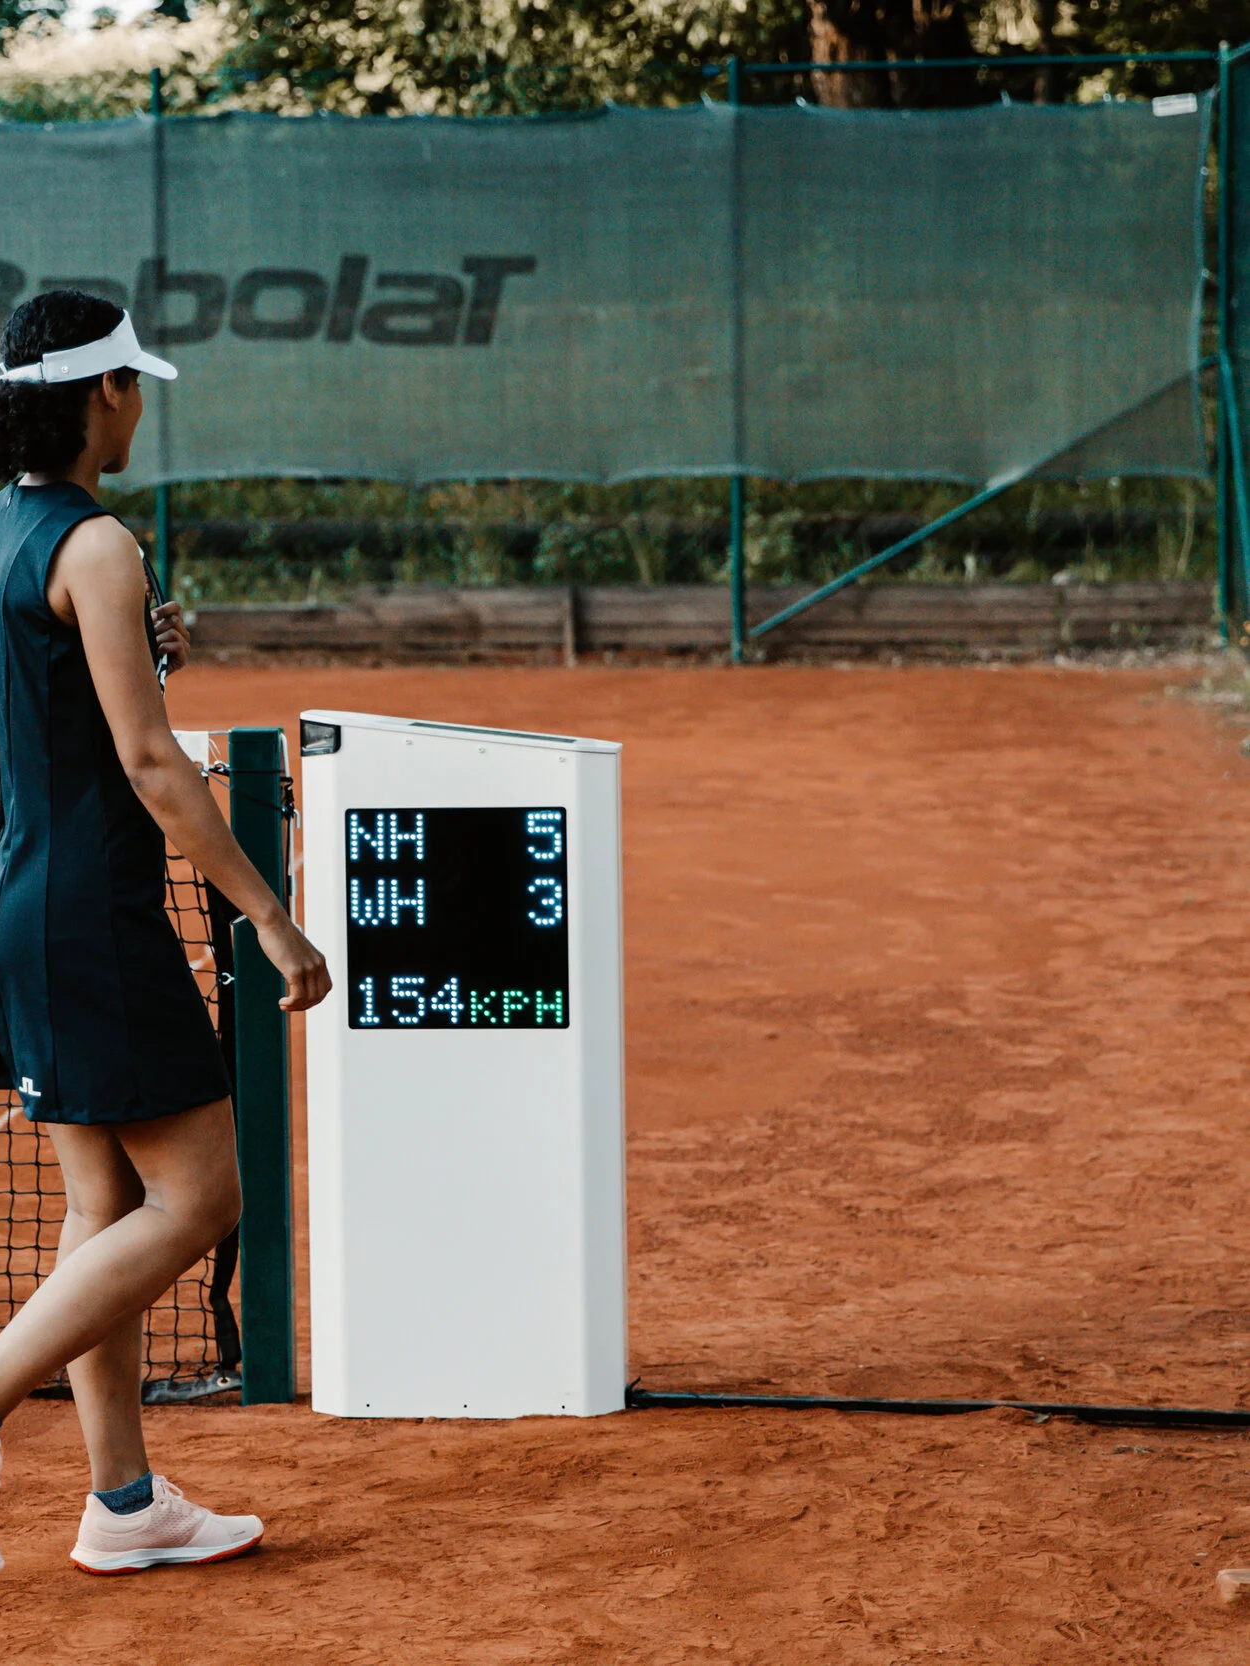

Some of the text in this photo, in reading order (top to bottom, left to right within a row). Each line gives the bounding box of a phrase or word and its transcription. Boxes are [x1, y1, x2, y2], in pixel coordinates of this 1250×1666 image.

[350, 811, 562, 861] NH 5
[350, 878, 563, 926] WH 3
